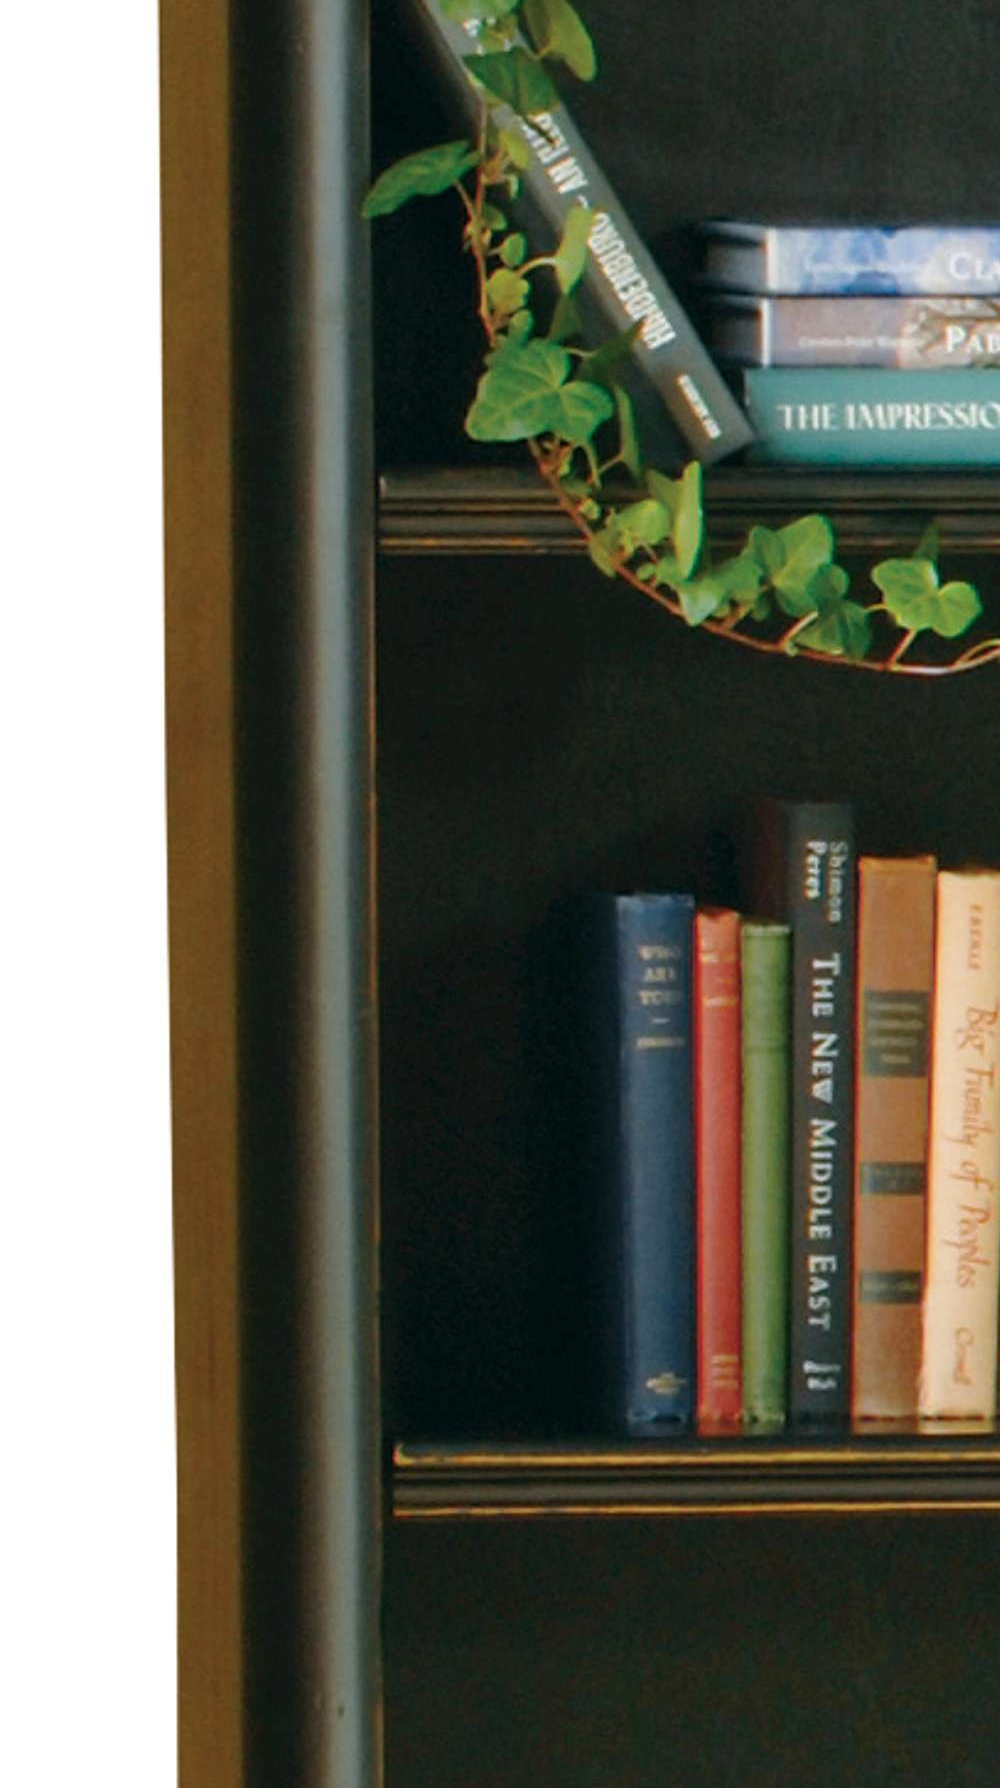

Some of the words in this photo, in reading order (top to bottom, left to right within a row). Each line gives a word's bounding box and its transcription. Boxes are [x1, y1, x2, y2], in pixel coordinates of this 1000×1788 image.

[546, 155, 589, 195] AN
[775, 402, 838, 431] THE
[805, 839, 828, 900] Peres
[828, 840, 848, 923] Shimon
[812, 952, 841, 1018] THE
[811, 1030, 841, 1105] NEW
[808, 1116, 838, 1240] MIDDLE
[951, 1160, 995, 1191] of
[807, 1255, 837, 1330] EAST
